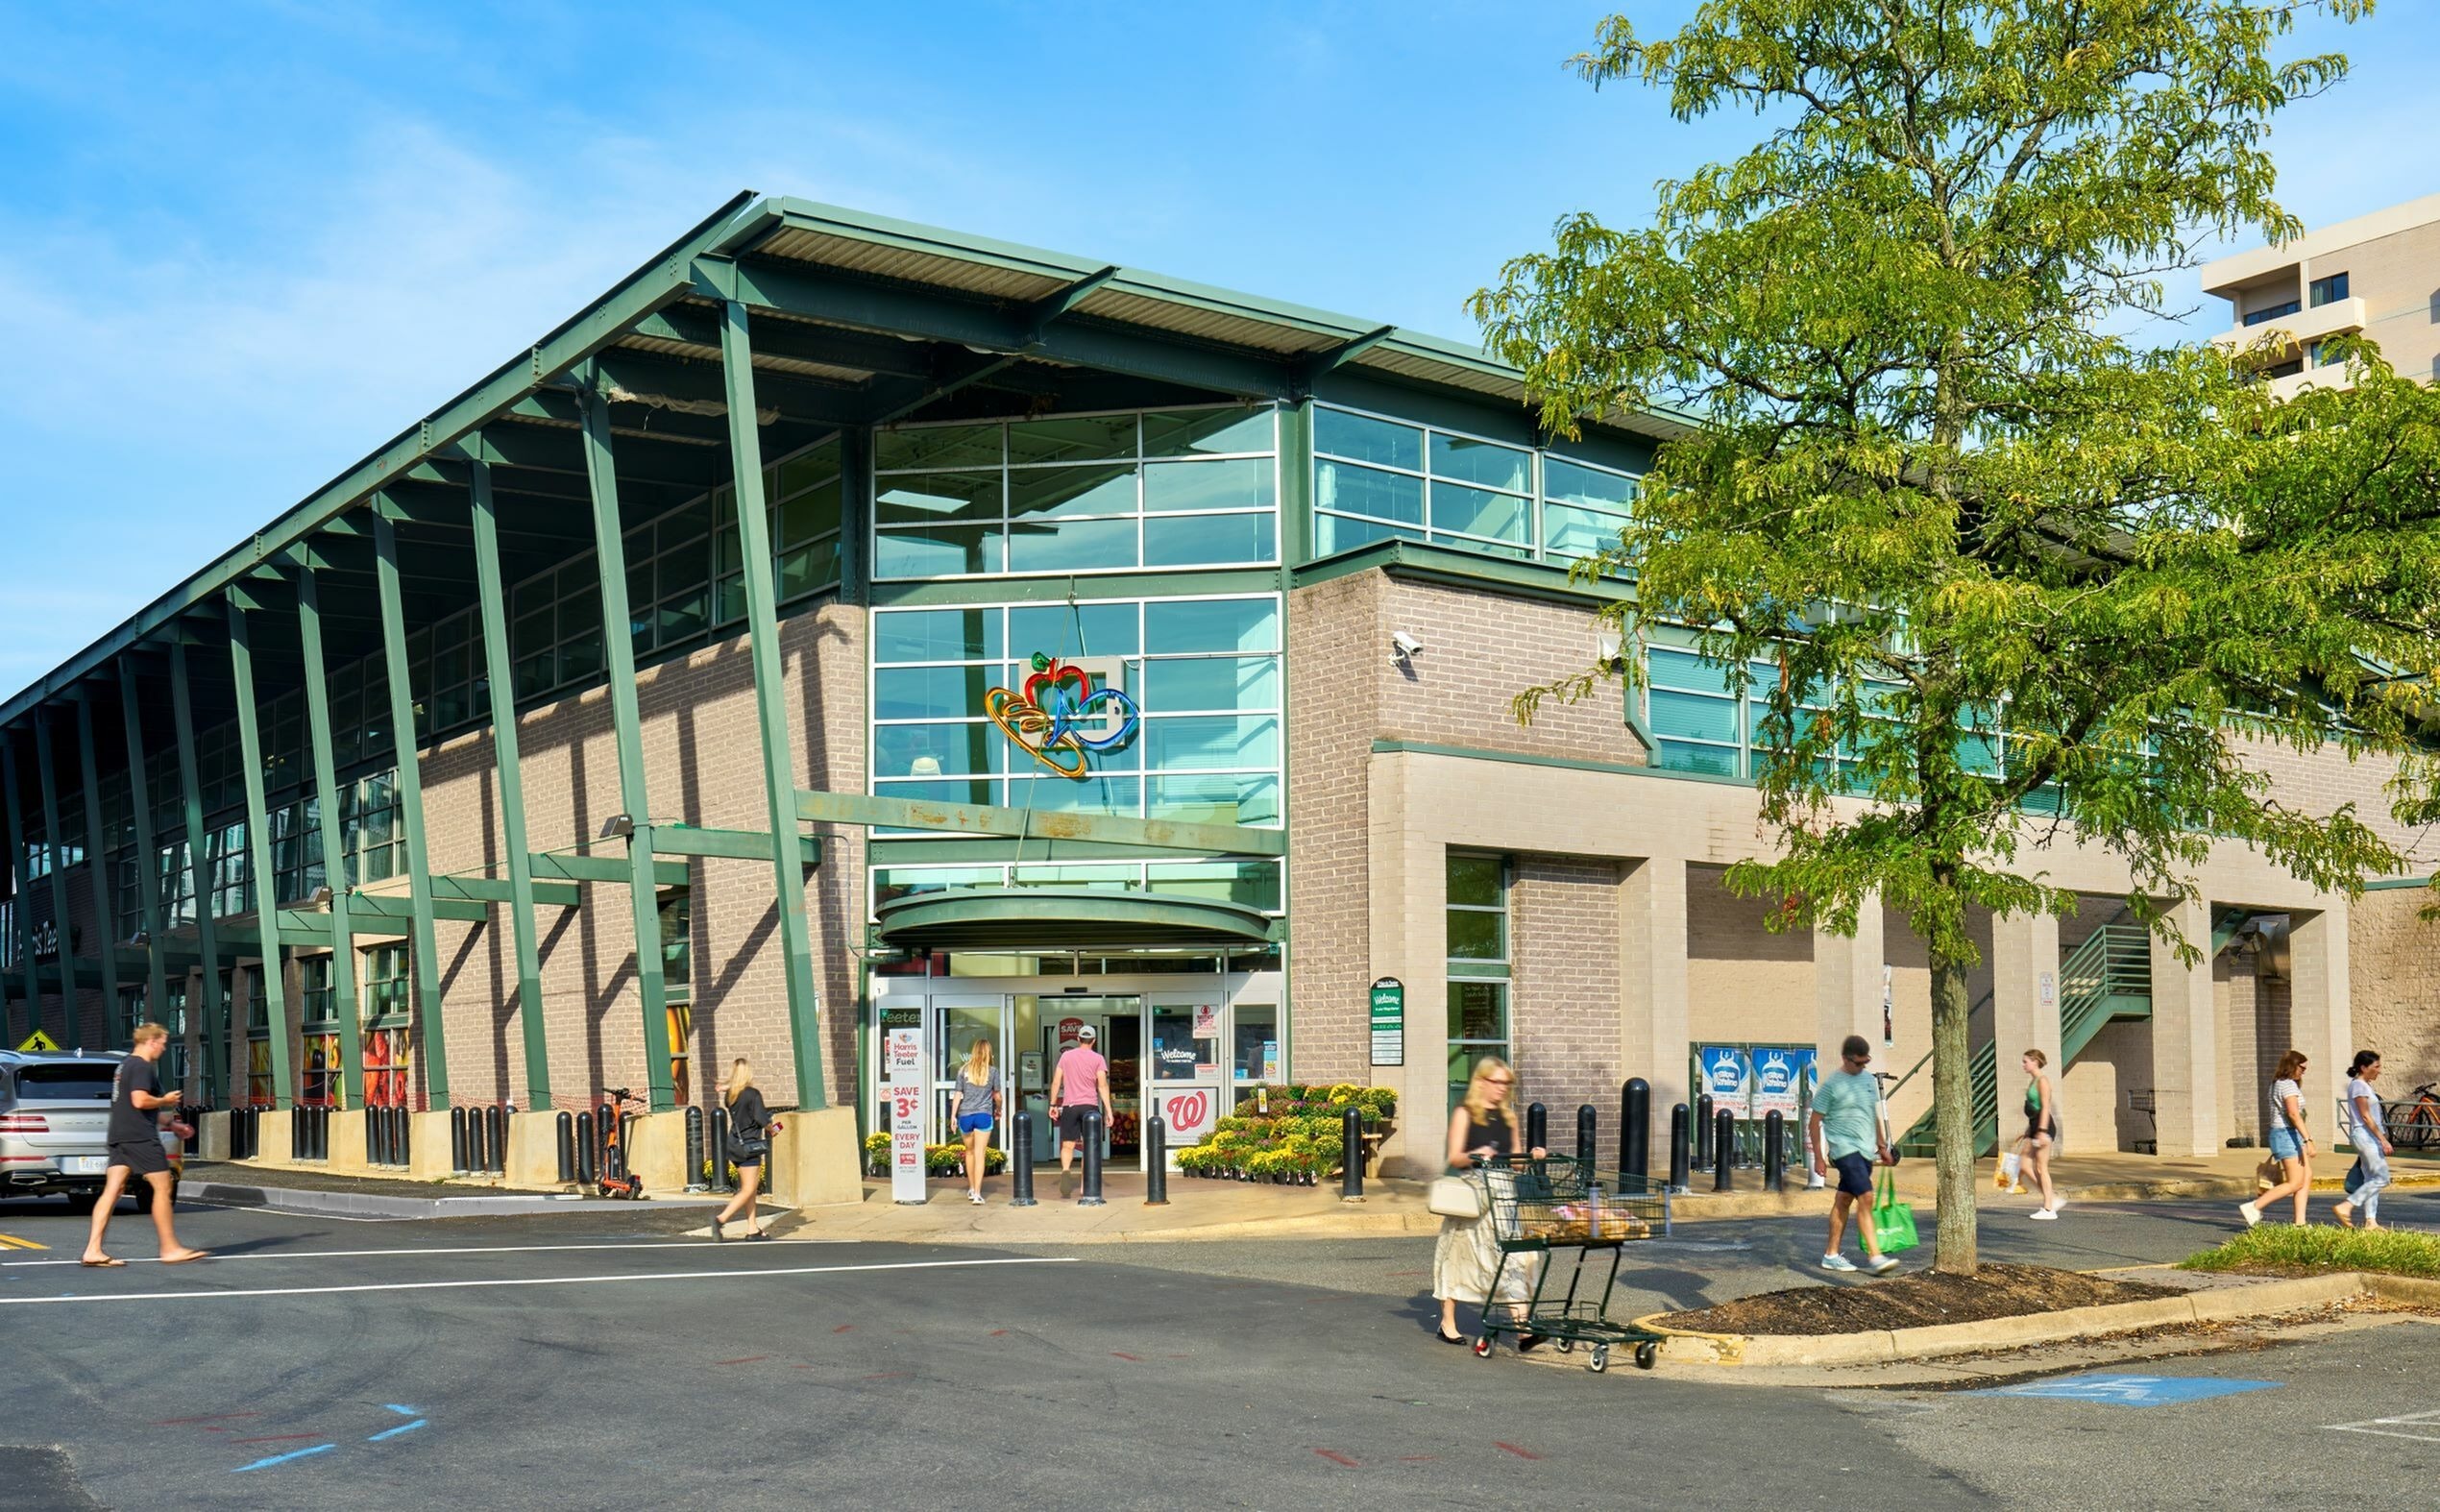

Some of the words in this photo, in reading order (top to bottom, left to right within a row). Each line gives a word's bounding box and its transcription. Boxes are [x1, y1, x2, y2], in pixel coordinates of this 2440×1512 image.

[1374, 992, 1400, 1006] Welcome
[1160, 1048, 1196, 1061] Welcome
[893, 1086, 919, 1096] SAVE
[896, 1097, 918, 1118] 3¢
